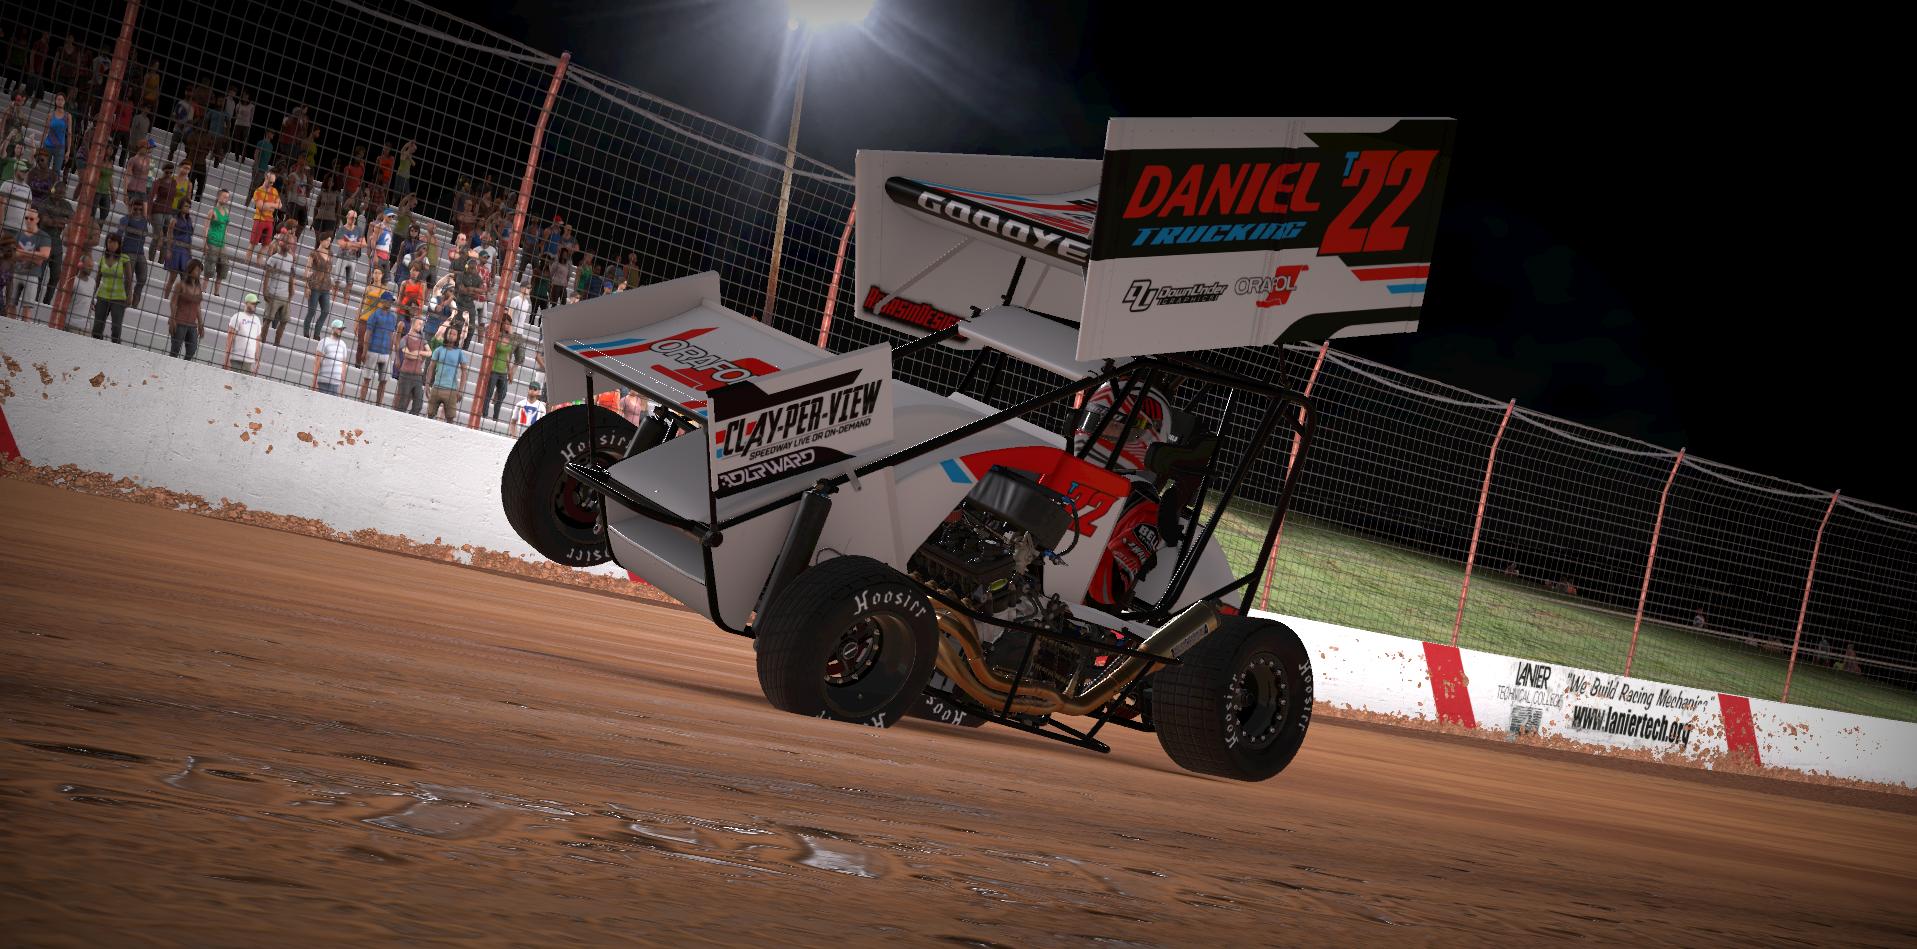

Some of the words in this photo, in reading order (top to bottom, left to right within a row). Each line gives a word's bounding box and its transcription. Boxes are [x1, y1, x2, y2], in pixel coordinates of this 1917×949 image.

[1122, 162, 1320, 219] DANIEL
[1234, 275, 1297, 295] ORAFOL
[723, 379, 882, 457] CLAY-PER-VIEW
[749, 442, 792, 460] SPEEDWAY
[794, 437, 810, 447] LIVE
[812, 433, 822, 442] OR
[824, 418, 871, 438] ON-DEMAND
[853, 589, 927, 618] Hoosier
[1515, 661, 1552, 690] LANIER
[1590, 677, 1619, 700] Build
[1619, 683, 1655, 711] Racing
[1571, 705, 1691, 748] www.laniertech.org
